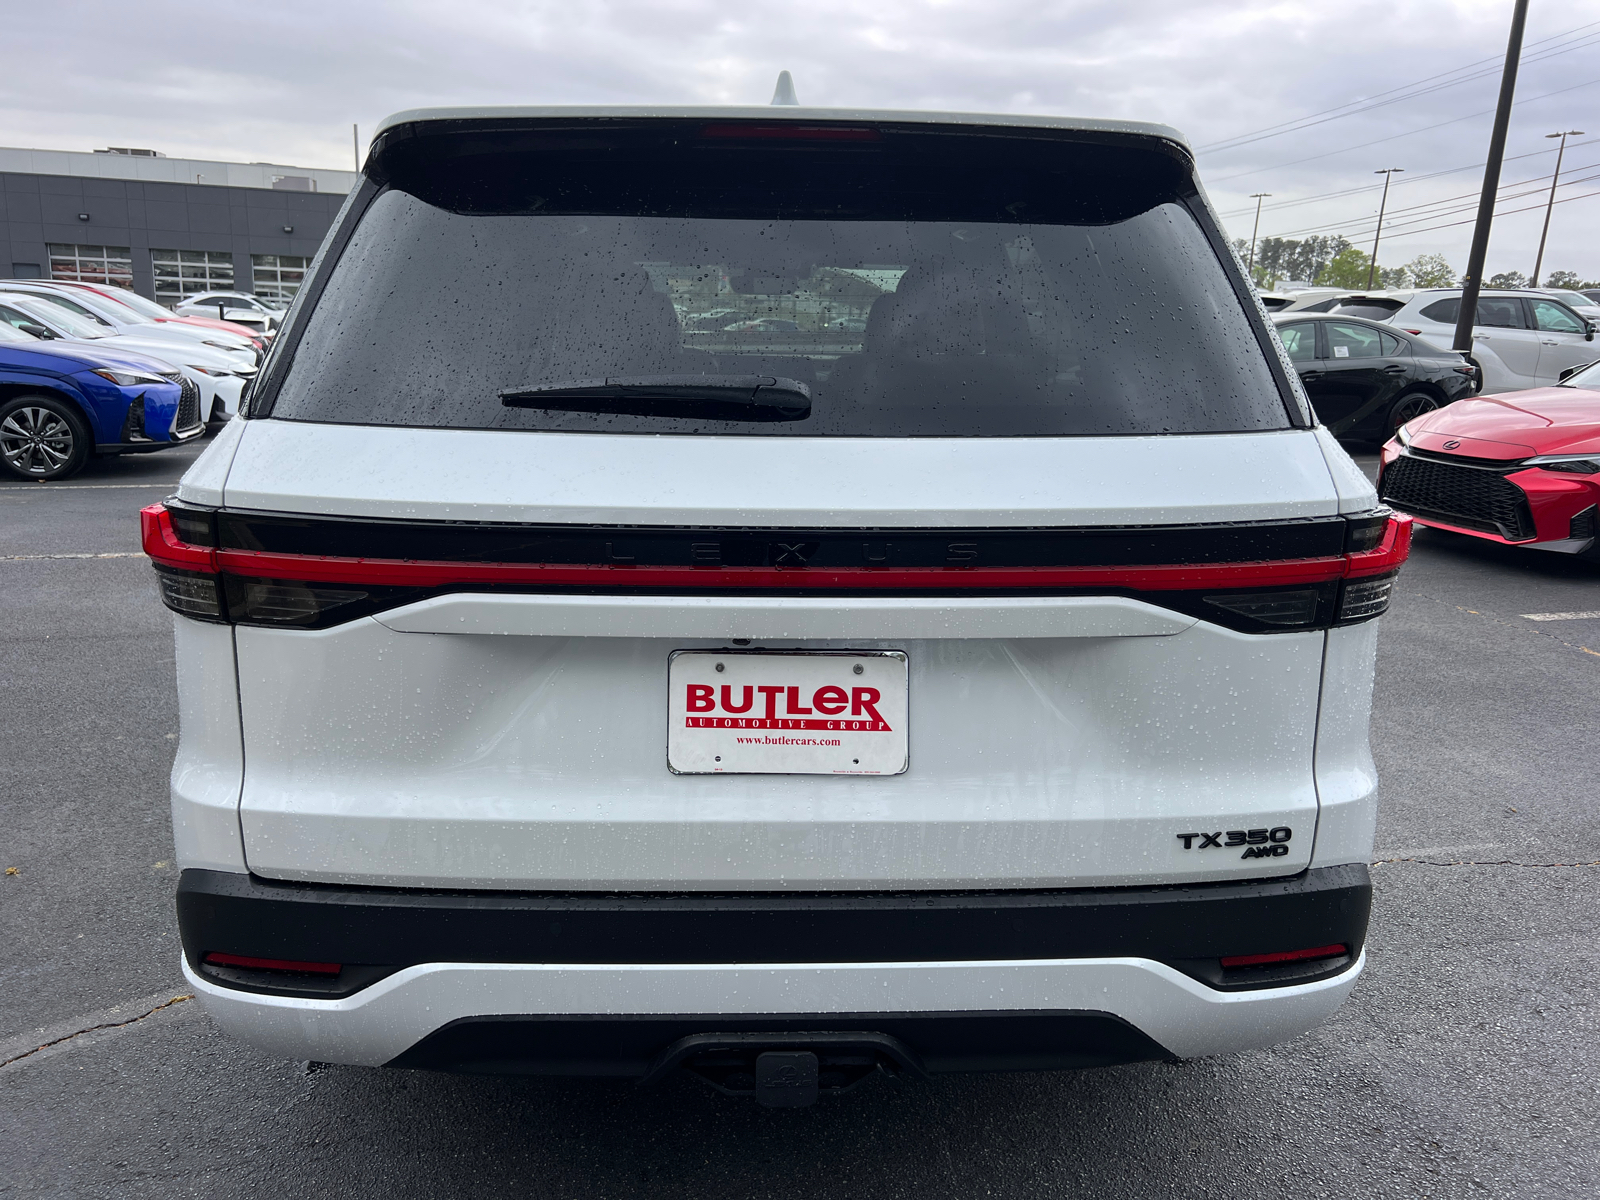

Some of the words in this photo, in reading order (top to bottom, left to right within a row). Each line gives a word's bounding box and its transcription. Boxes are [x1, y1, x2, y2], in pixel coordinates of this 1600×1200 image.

[606, 541, 979, 562] LEXUS
[686, 718, 807, 729] AUTOMOTIVE
[826, 720, 886, 731] GROUP
[736, 736, 841, 747] www.butlercars.com
[1240, 844, 1289, 860] AWD
